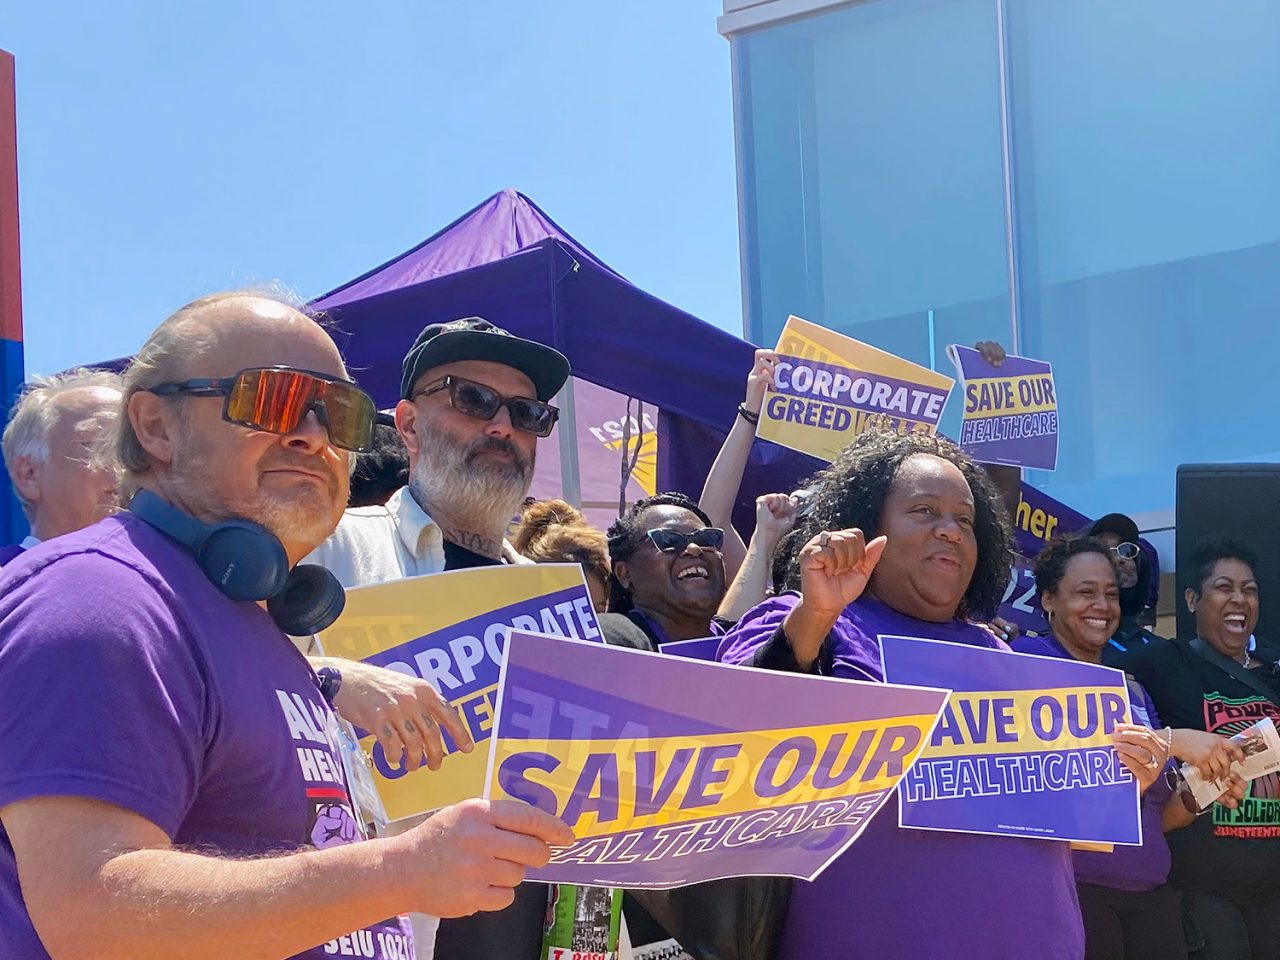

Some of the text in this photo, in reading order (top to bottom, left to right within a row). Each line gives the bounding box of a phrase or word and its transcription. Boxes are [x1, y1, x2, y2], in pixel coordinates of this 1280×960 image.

[774, 362, 945, 420] CORPORATE
[966, 377, 1056, 413] SAVE OUR
[767, 396, 852, 432] GREED
[962, 412, 1057, 445] HEALTHCARE
[930, 698, 1020, 748] AVE
[1030, 692, 1127, 742] OUR
[497, 743, 743, 828] SAVE
[754, 724, 922, 798] OUR
[905, 748, 1133, 803] HEALTHCARE
[324, 930, 375, 958] SEIU
